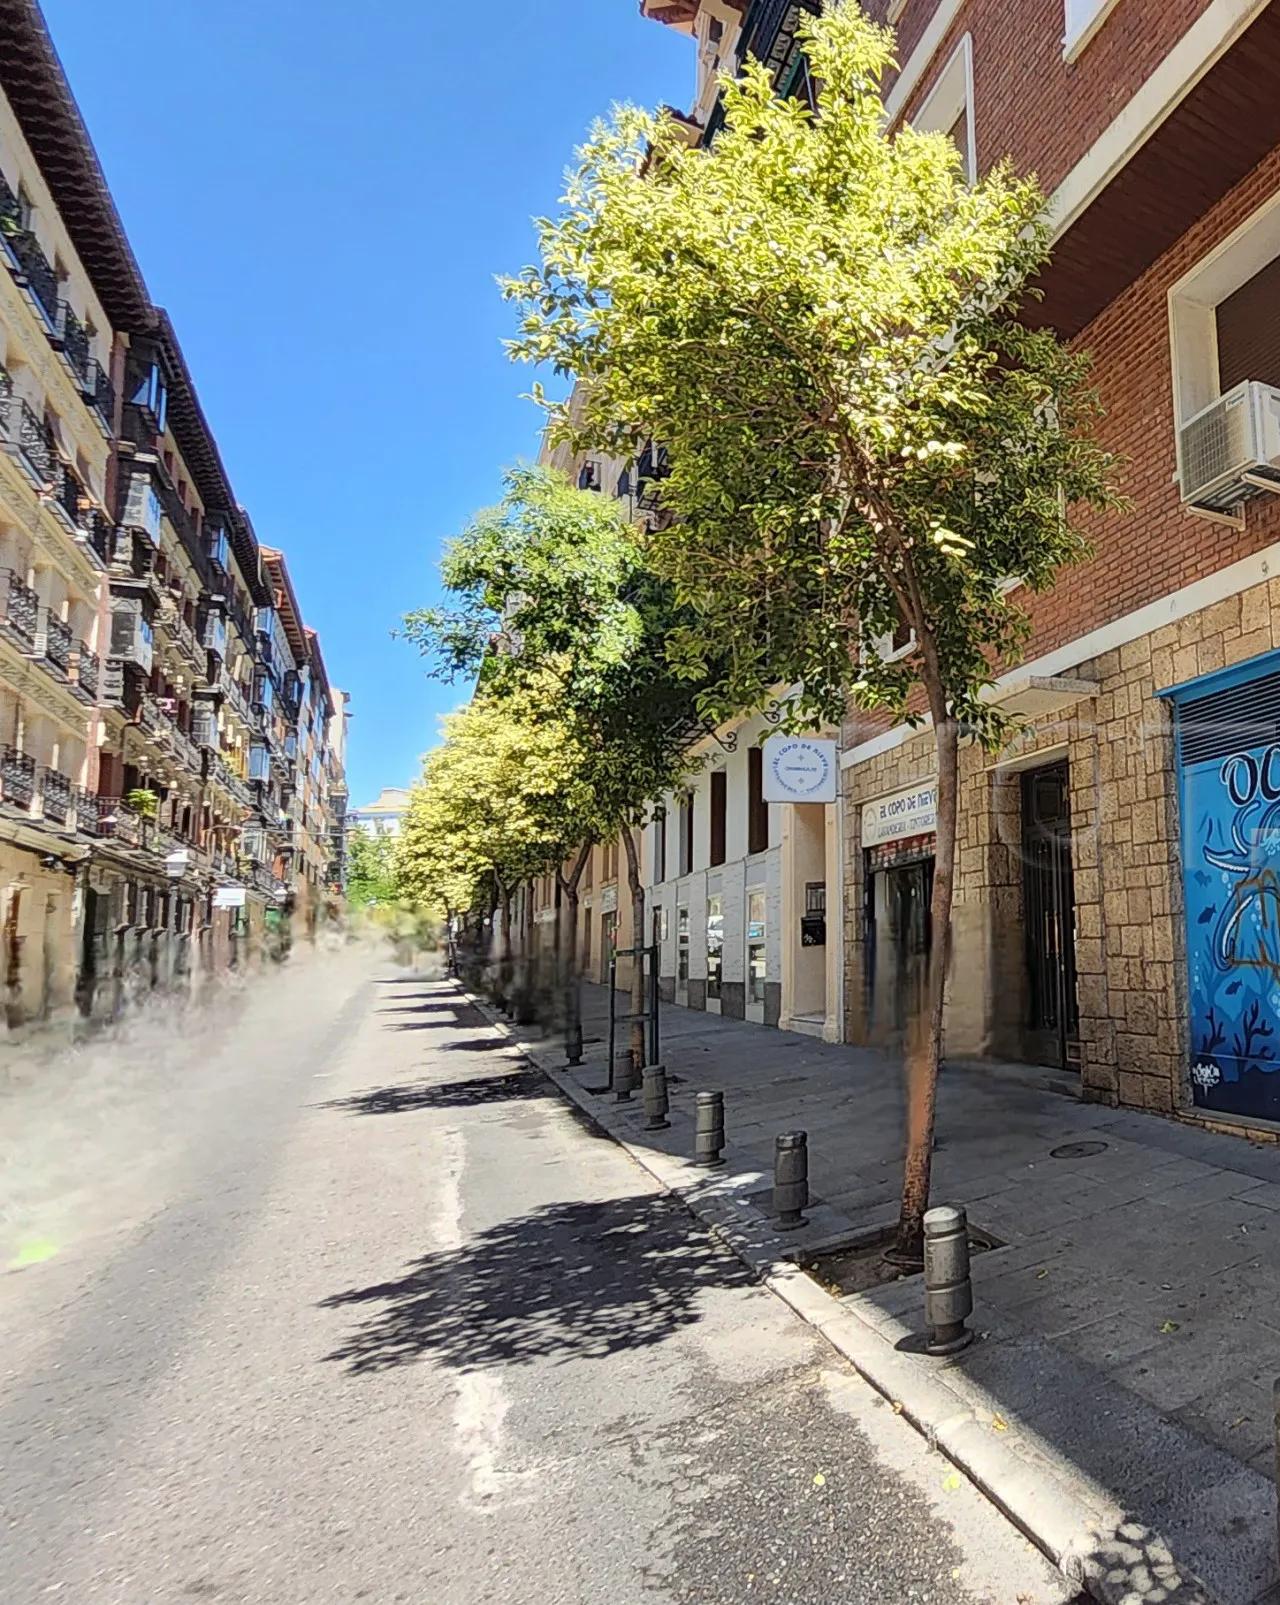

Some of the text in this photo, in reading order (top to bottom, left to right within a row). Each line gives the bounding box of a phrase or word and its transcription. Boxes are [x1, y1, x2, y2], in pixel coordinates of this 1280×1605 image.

[779, 743, 798, 756] COPO
[880, 805, 887, 819] EL
[888, 798, 906, 817] COPO
[907, 795, 917, 811] DE
